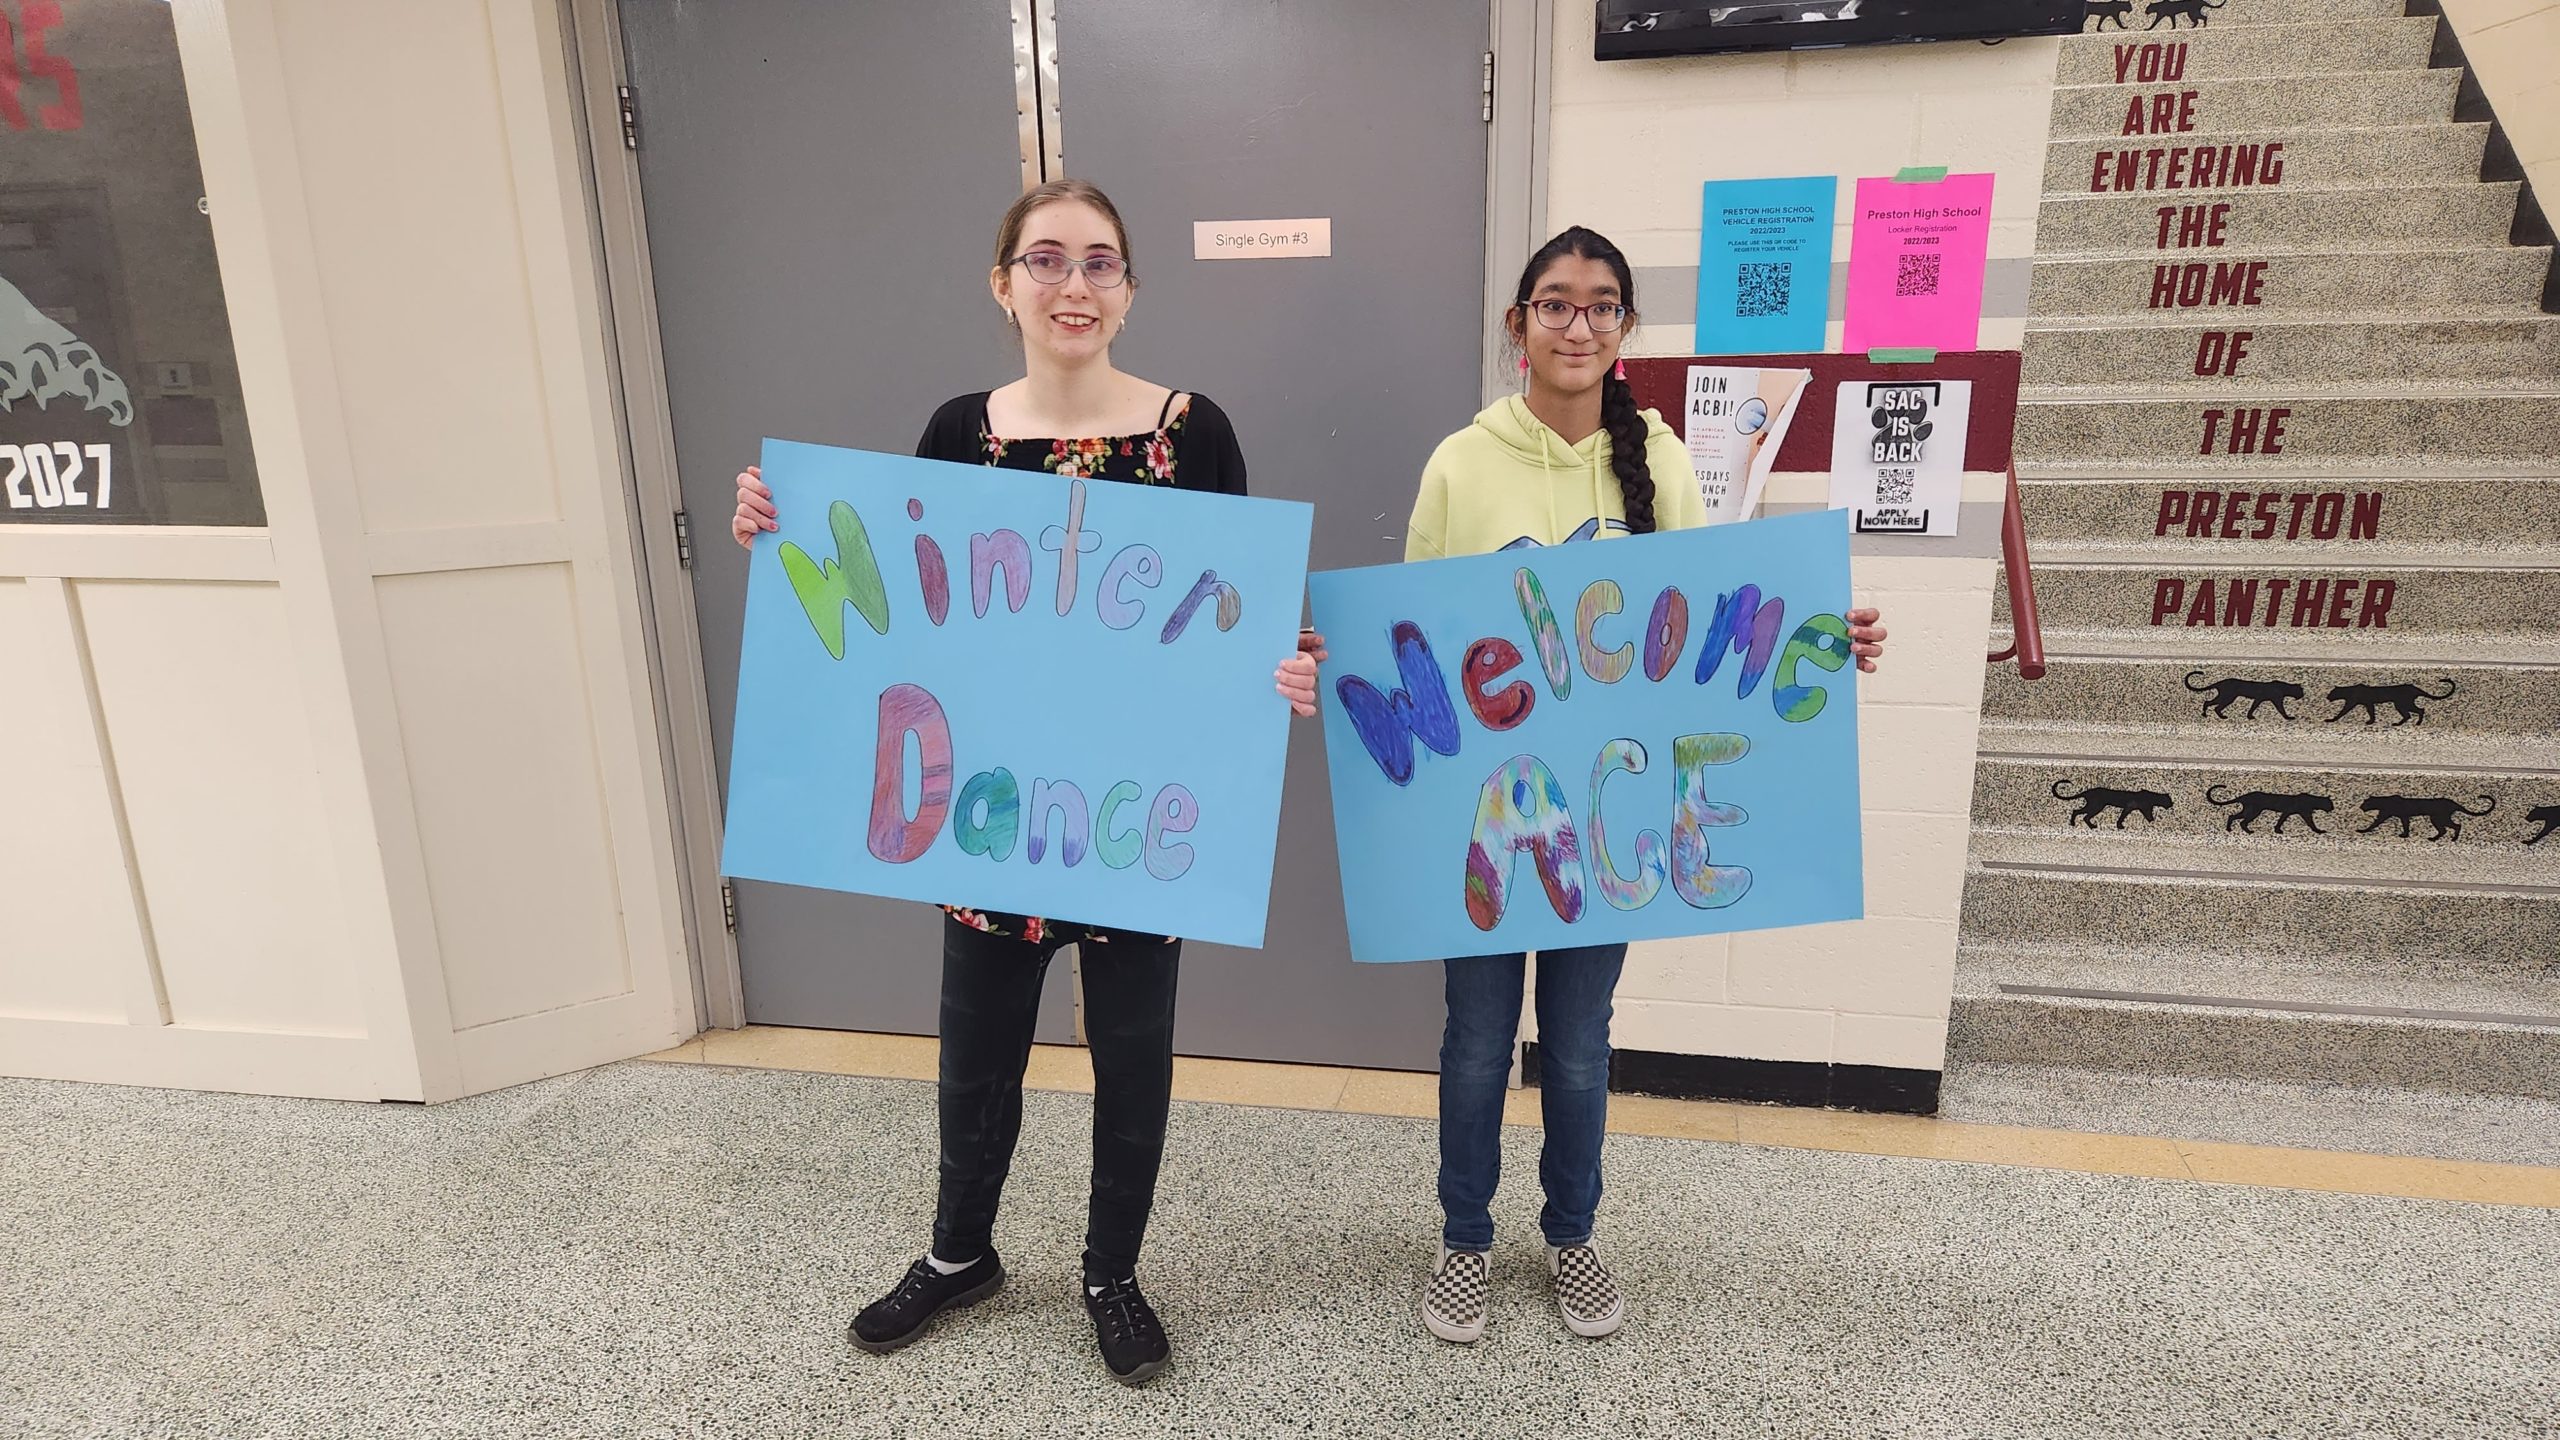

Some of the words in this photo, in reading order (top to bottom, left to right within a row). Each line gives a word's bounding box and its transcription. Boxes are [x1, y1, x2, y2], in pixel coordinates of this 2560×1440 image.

[2114, 43, 2187, 84] YOU
[2122, 91, 2198, 136] ARE
[2091, 143, 2284, 192] ENTERING
[1723, 208, 1760, 216] PRESTON
[1782, 206, 1815, 214] SCHOOL
[1723, 218, 1756, 226] VEHICLE
[1757, 216, 1815, 225] REGISTRATION
[1868, 210, 1910, 219] Preston
[1913, 208, 1939, 220] High
[1942, 207, 1981, 217] School
[1750, 227, 1786, 235] 2022/2023
[1914, 225, 1957, 234] Registration
[2156, 204, 2230, 249] THE
[1215, 233, 1254, 248] Single
[1258, 232, 1289, 248] Gym
[1292, 231, 1309, 245] #3
[1903, 237, 1940, 246] 2022/2023
[2148, 261, 2269, 308] HOME
[2193, 331, 2252, 376] OF
[1694, 376, 1728, 394] JOIN
[1692, 399, 1734, 417] ACBI!
[1884, 390, 1922, 411] SAC
[1891, 416, 1910, 437] IS
[2199, 408, 2291, 454] THE
[1873, 442, 1923, 462] BACK
[0, 441, 111, 508] 2027
[1702, 484, 1727, 495] UNCH
[1864, 517, 1892, 526] NOW
[1893, 516, 1920, 526] HERE
[1877, 508, 1909, 517] APPLY
[2154, 490, 2382, 540] PRESTON
[779, 480, 1241, 661] Winter
[2150, 580, 2396, 628] PANTHER
[1336, 567, 1852, 786] Welcome
[867, 683, 1199, 881] Dance
[1464, 733, 1752, 931] ACE
